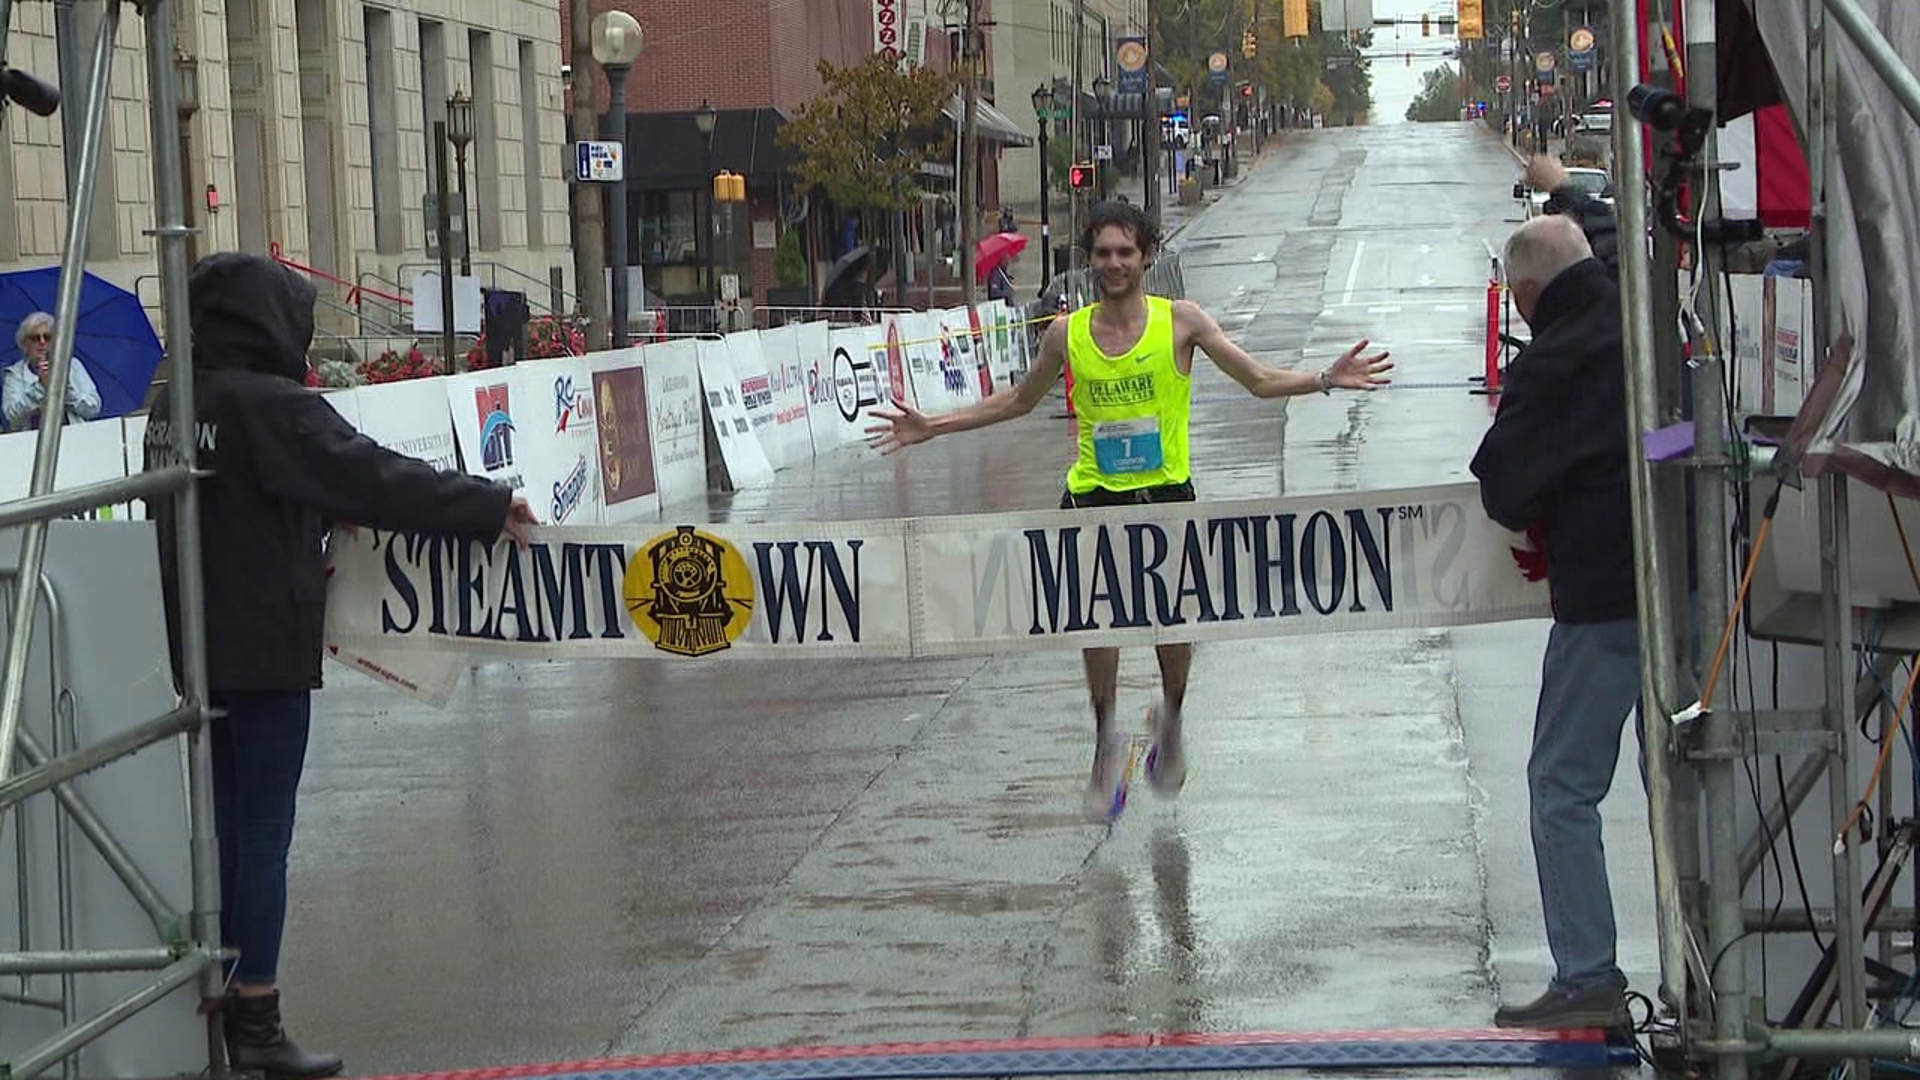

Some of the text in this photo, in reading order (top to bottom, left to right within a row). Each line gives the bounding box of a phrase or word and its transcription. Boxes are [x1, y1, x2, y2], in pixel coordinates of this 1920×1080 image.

[1089, 375, 1154, 396] DELAWARE
[1121, 438, 1131, 458] 1
[1023, 506, 1395, 635] MARATHON
